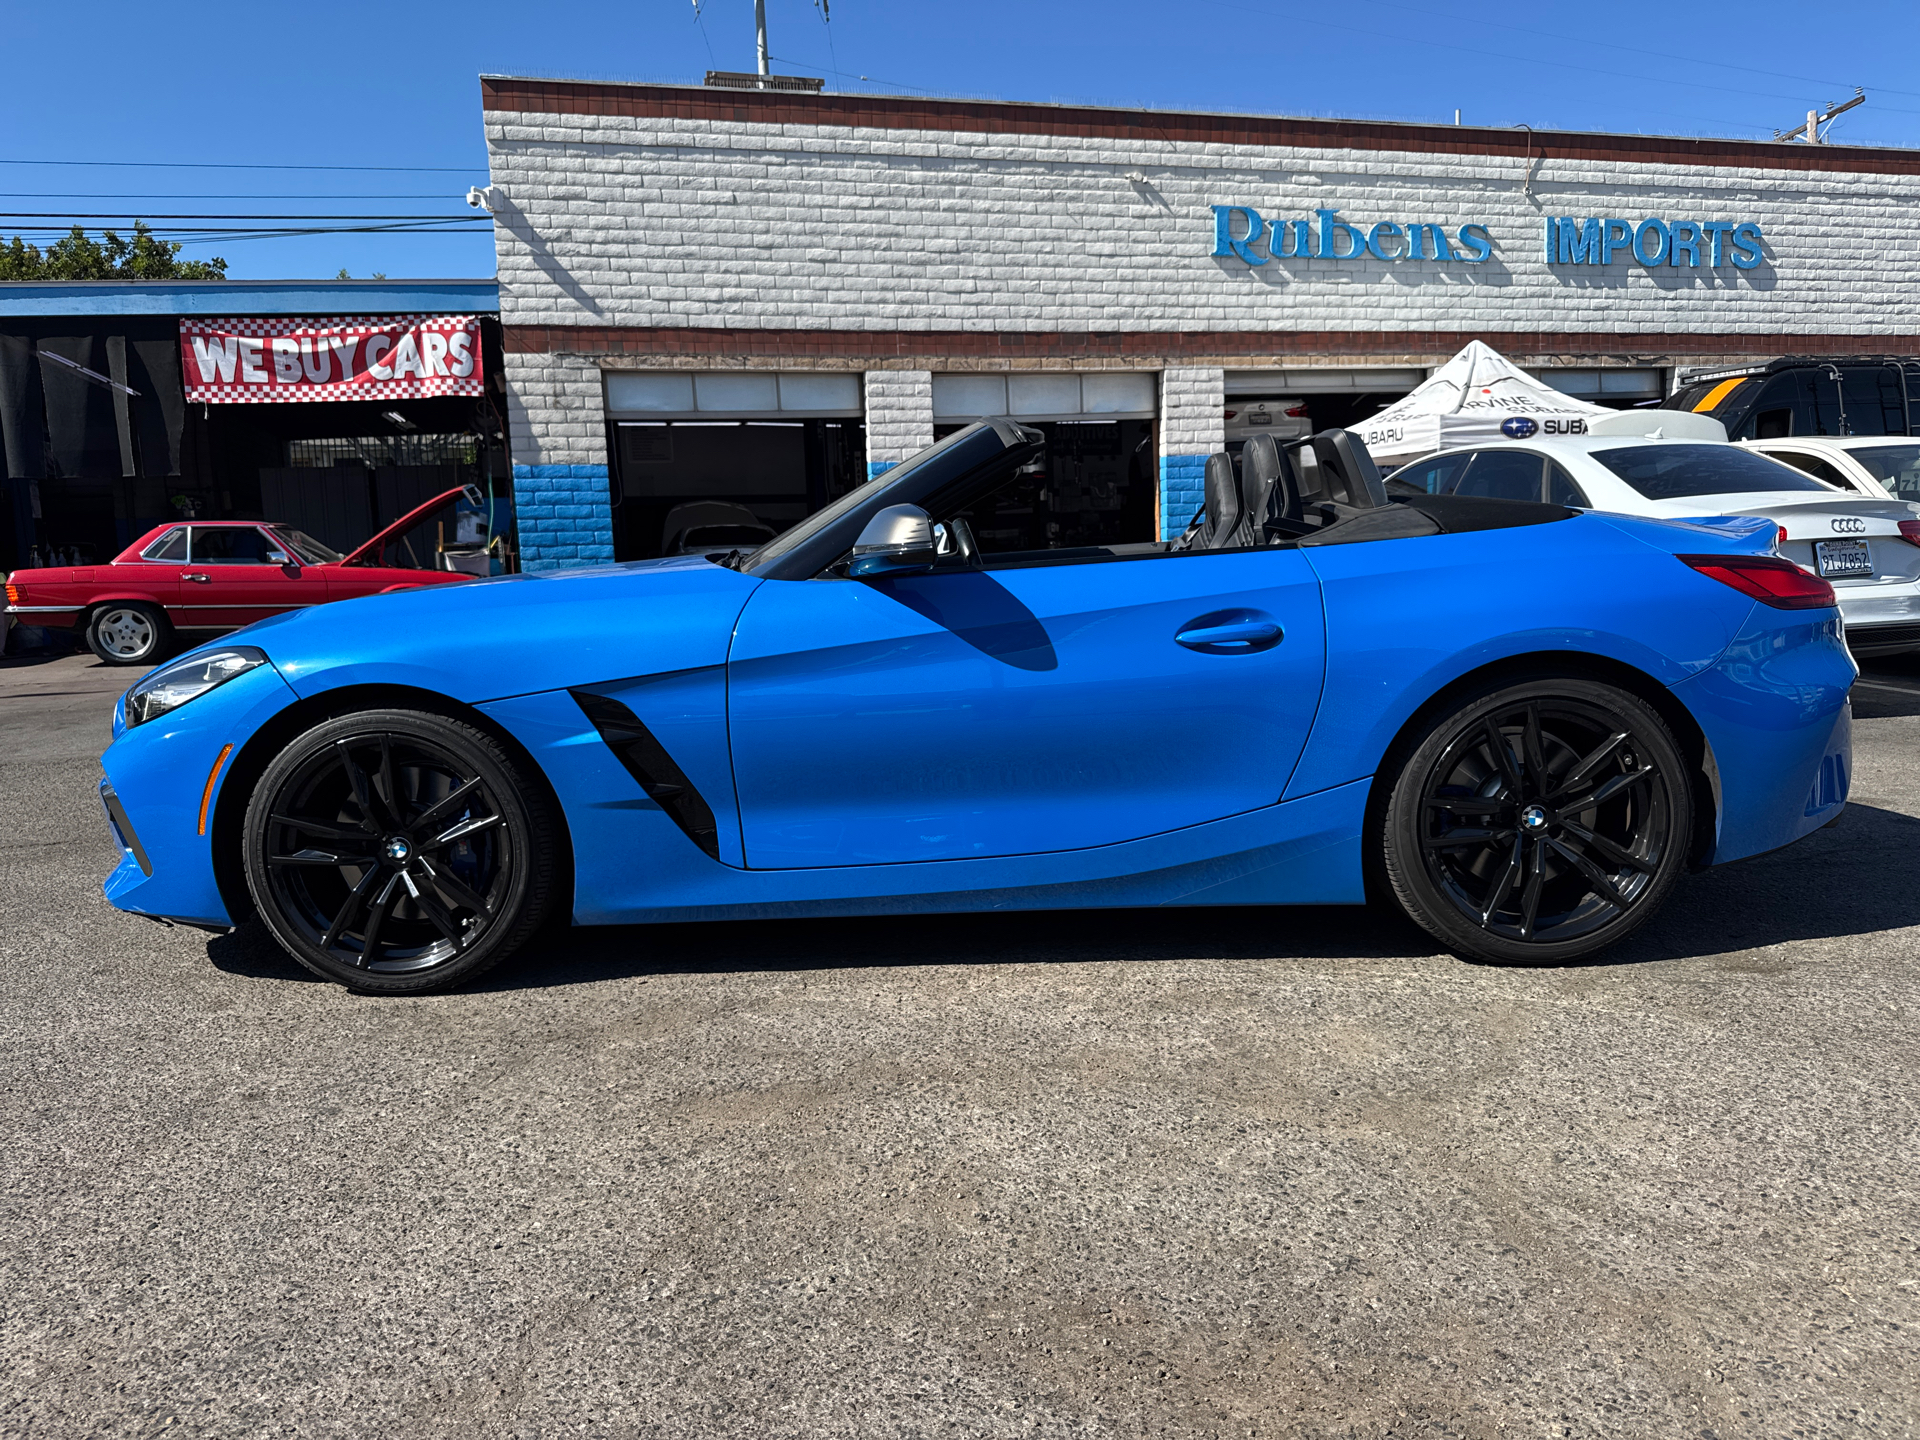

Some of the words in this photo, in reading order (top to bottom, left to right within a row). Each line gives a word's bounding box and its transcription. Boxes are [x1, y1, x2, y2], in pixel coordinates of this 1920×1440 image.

[1210, 205, 1492, 267] Rubens
[1543, 216, 1764, 269] IMPORTS
[190, 336, 269, 384] WE
[271, 335, 360, 384] BUY
[365, 331, 474, 381] CARS
[1053, 426, 1119, 440] ADDITIVES
[1358, 427, 1404, 446] UBARU
